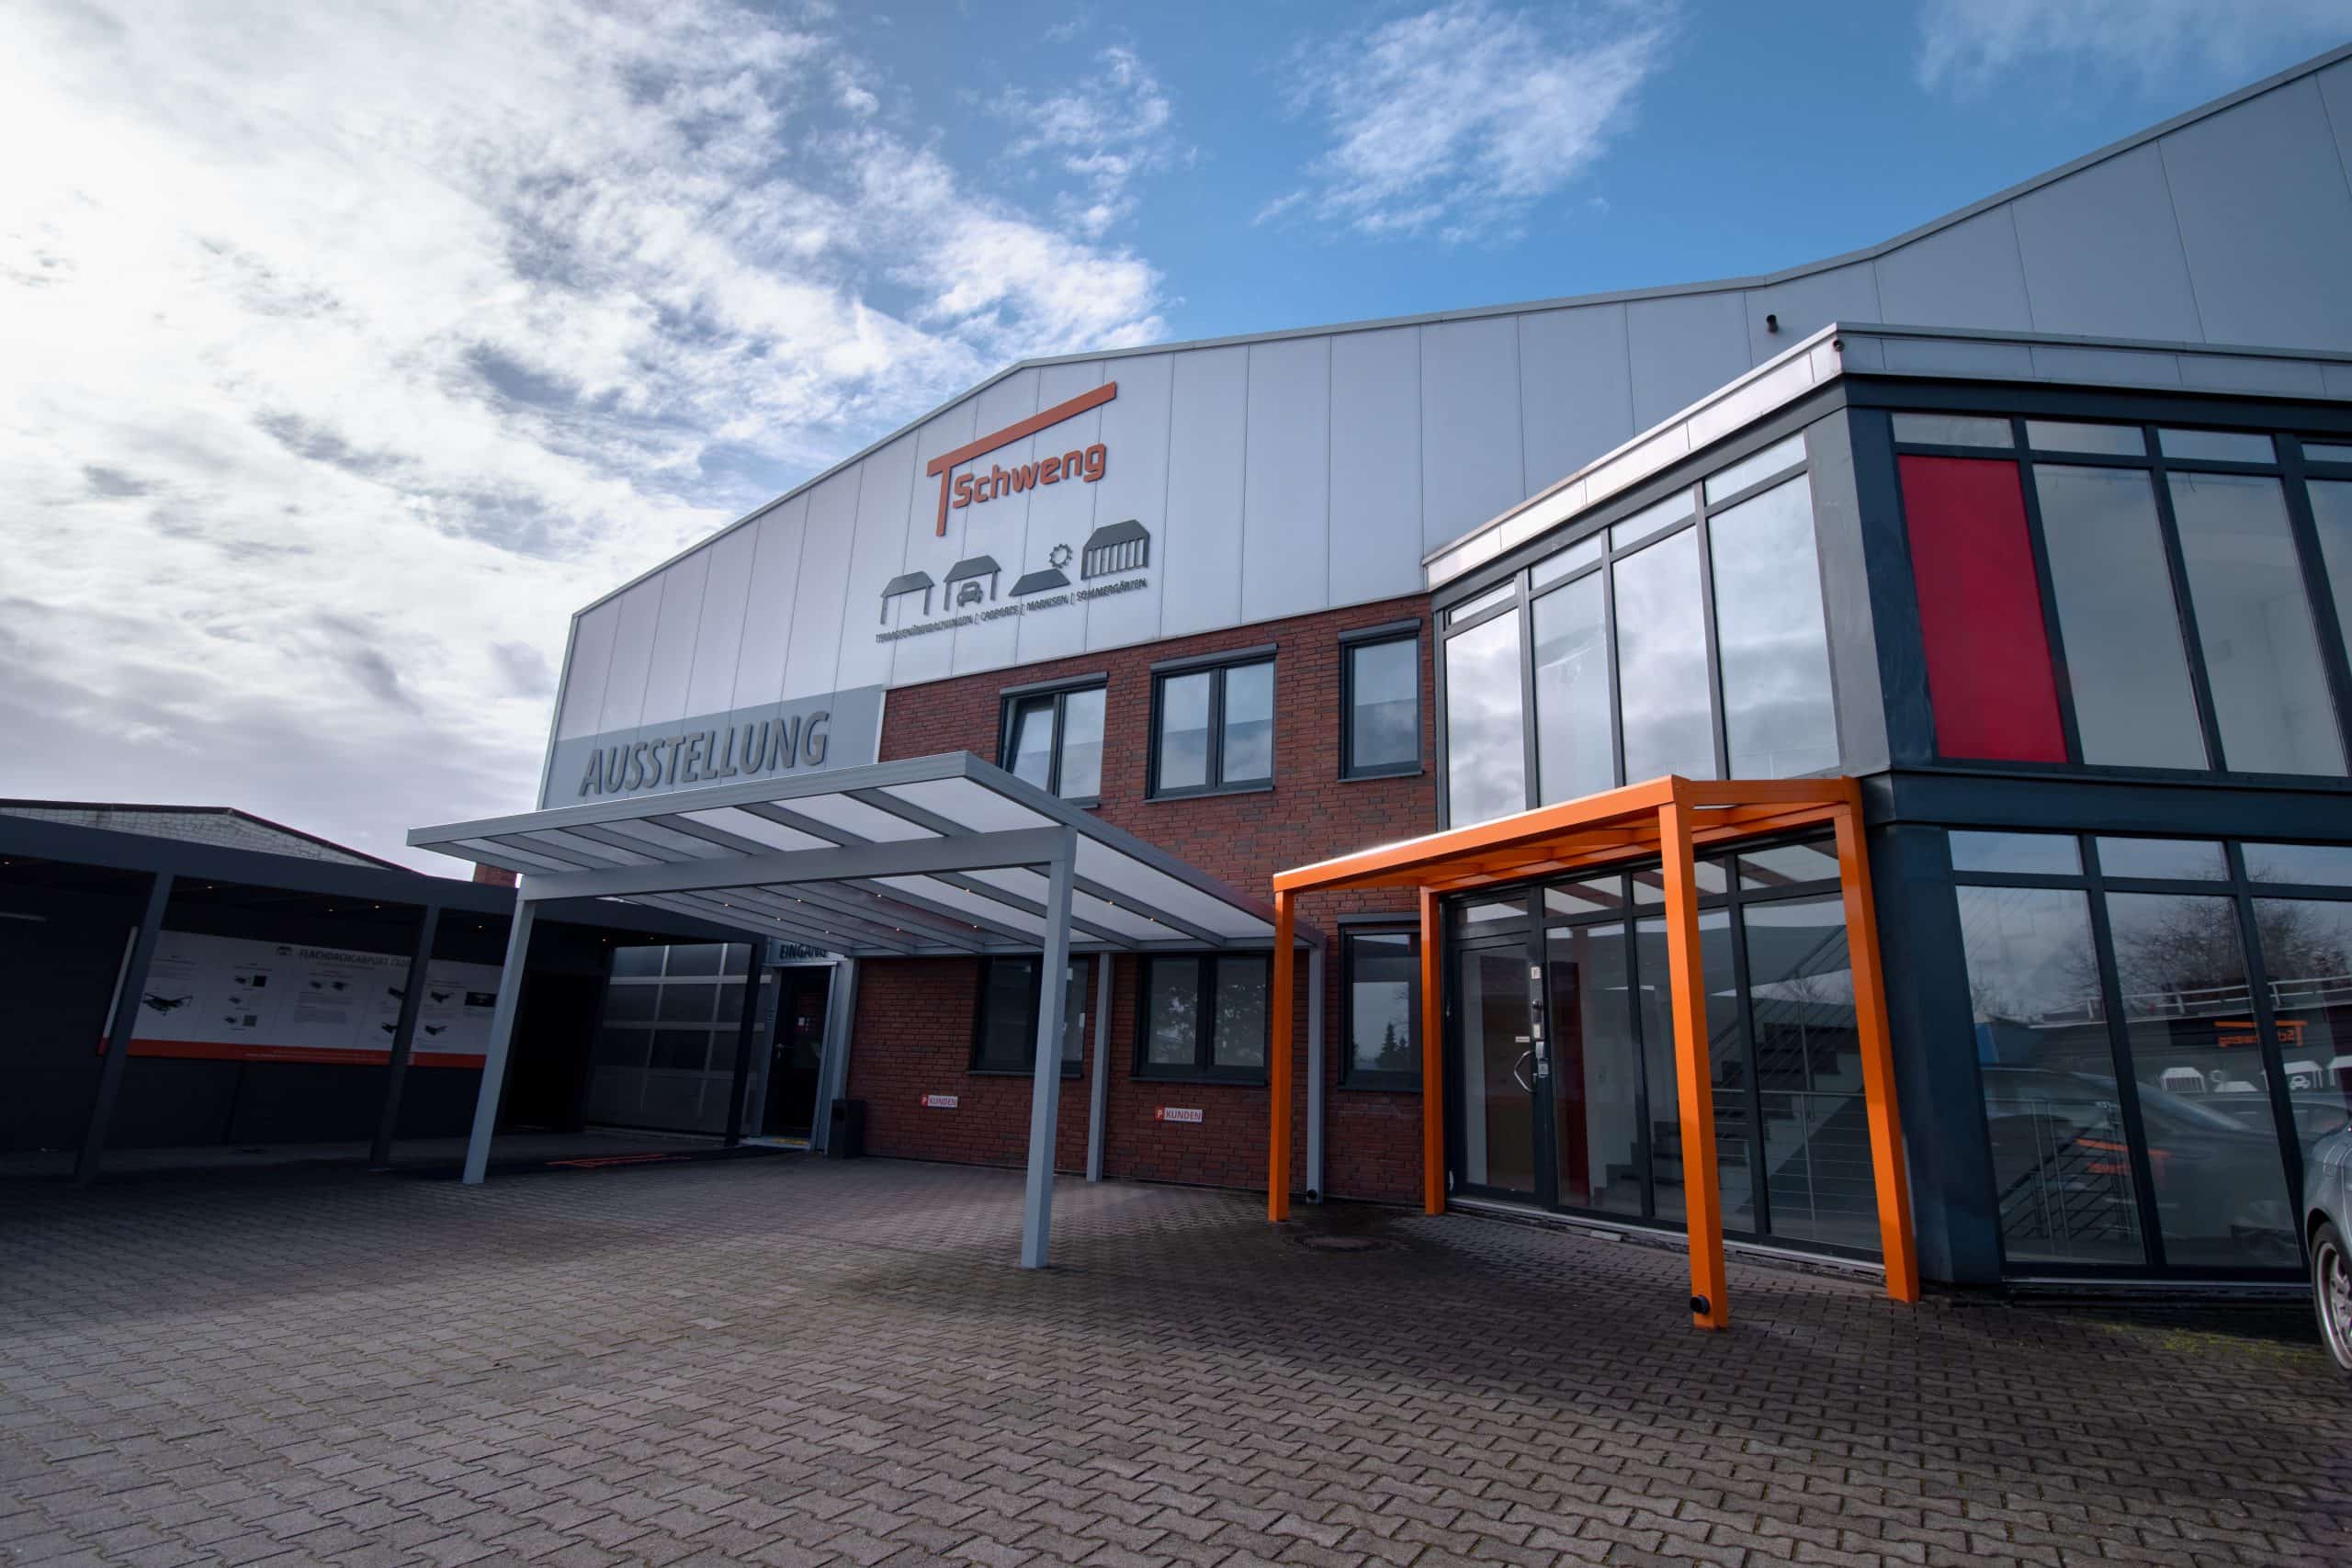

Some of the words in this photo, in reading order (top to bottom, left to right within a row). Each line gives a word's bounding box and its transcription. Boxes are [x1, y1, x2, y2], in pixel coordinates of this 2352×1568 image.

[578, 710, 831, 797] AUSSTELLUNG
[928, 1097, 956, 1106] KUNDEN
[1166, 1109, 1201, 1120] KUNDEN
